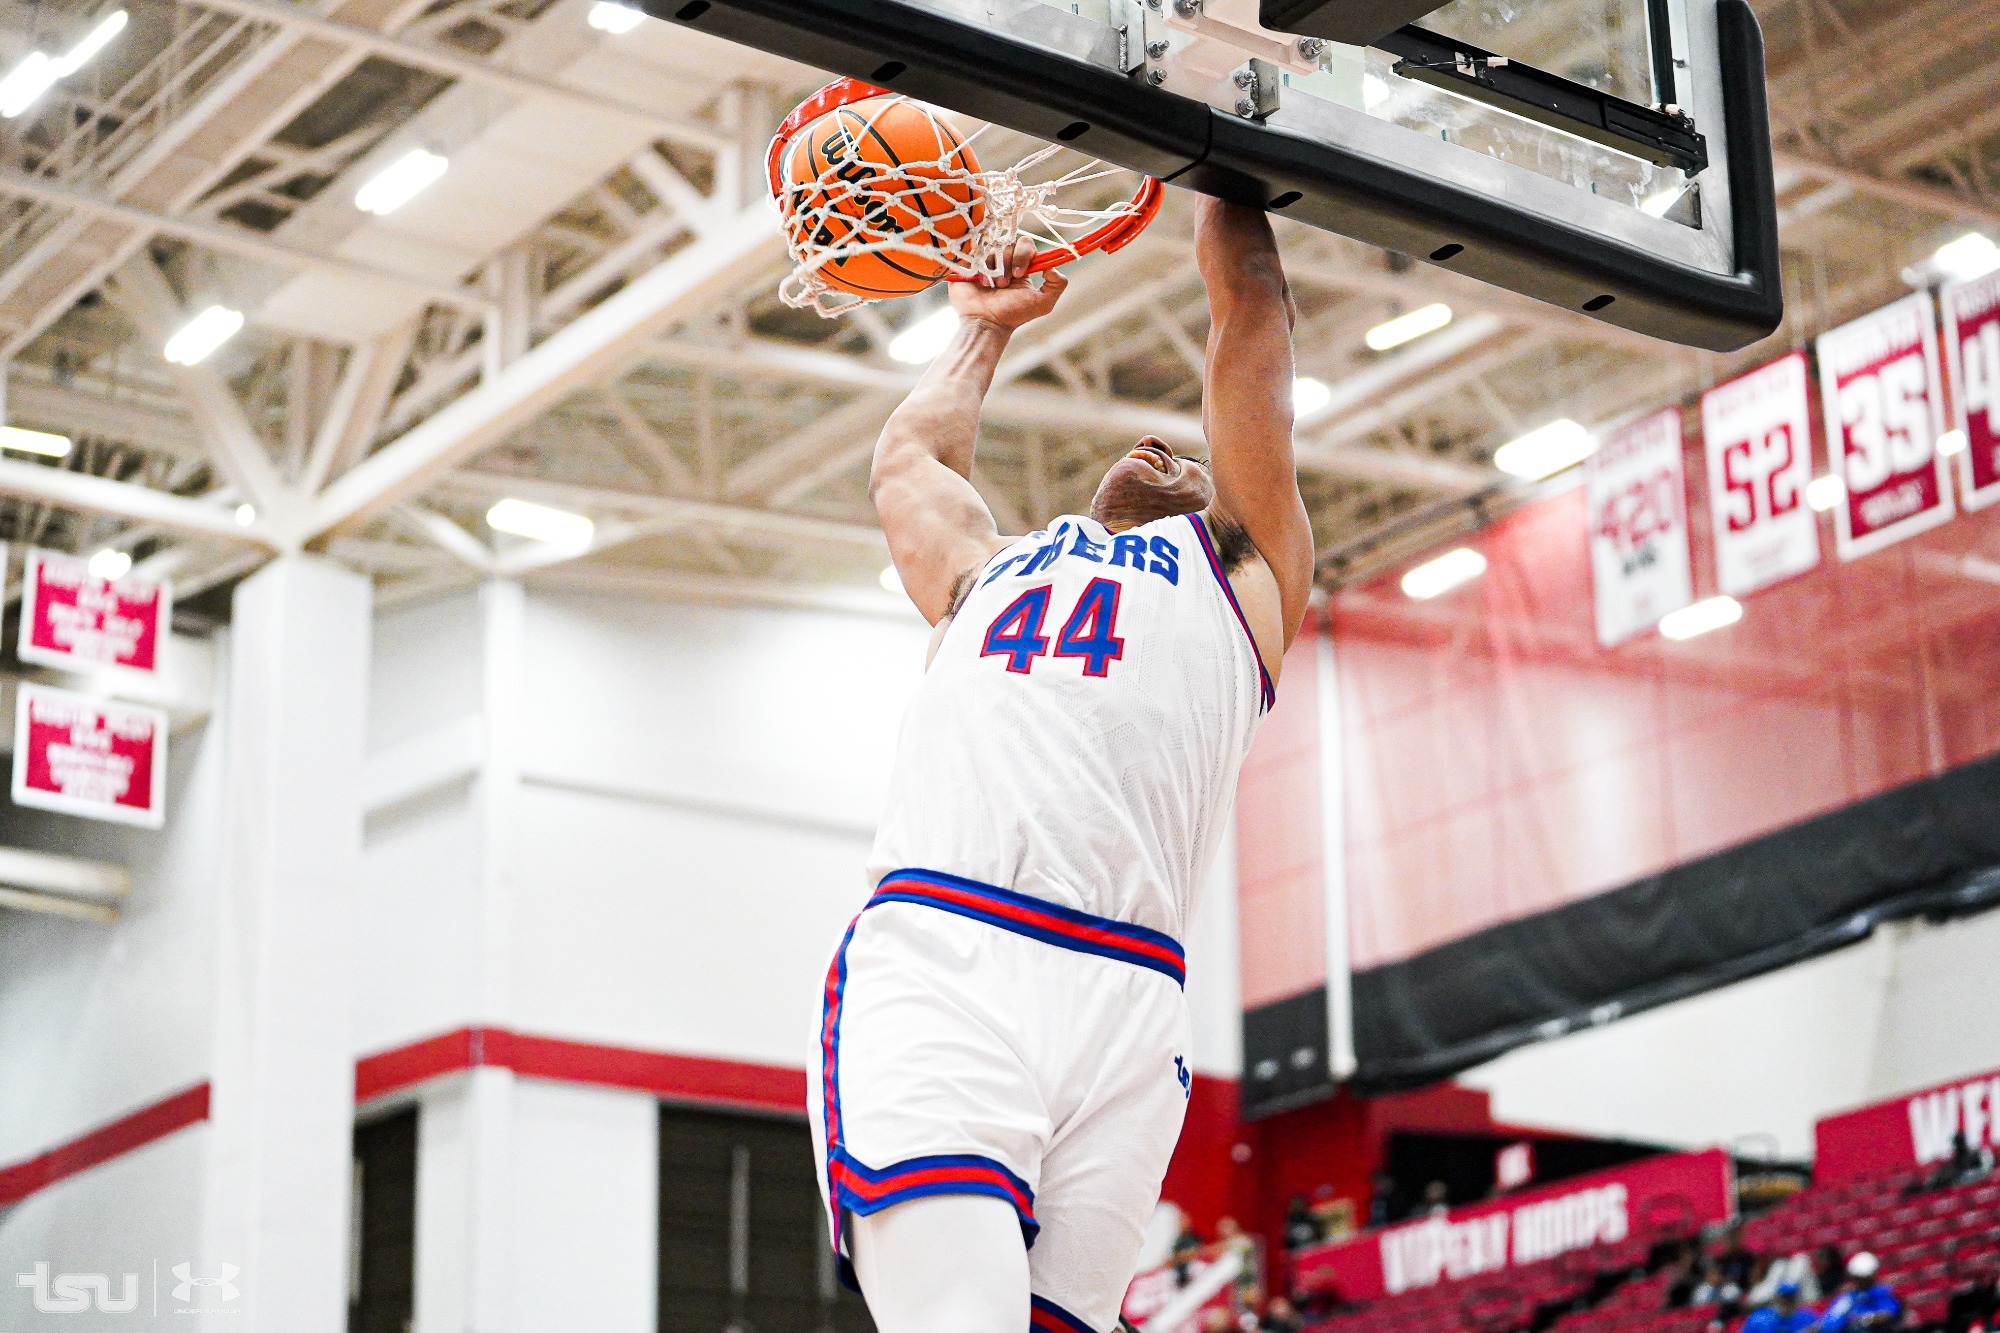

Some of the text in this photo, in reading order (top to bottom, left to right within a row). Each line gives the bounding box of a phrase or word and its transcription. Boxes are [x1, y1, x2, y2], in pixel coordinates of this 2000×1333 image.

[1722, 422, 1799, 534] 52
[1839, 352, 1933, 494] 35
[980, 576, 1125, 678] 44
